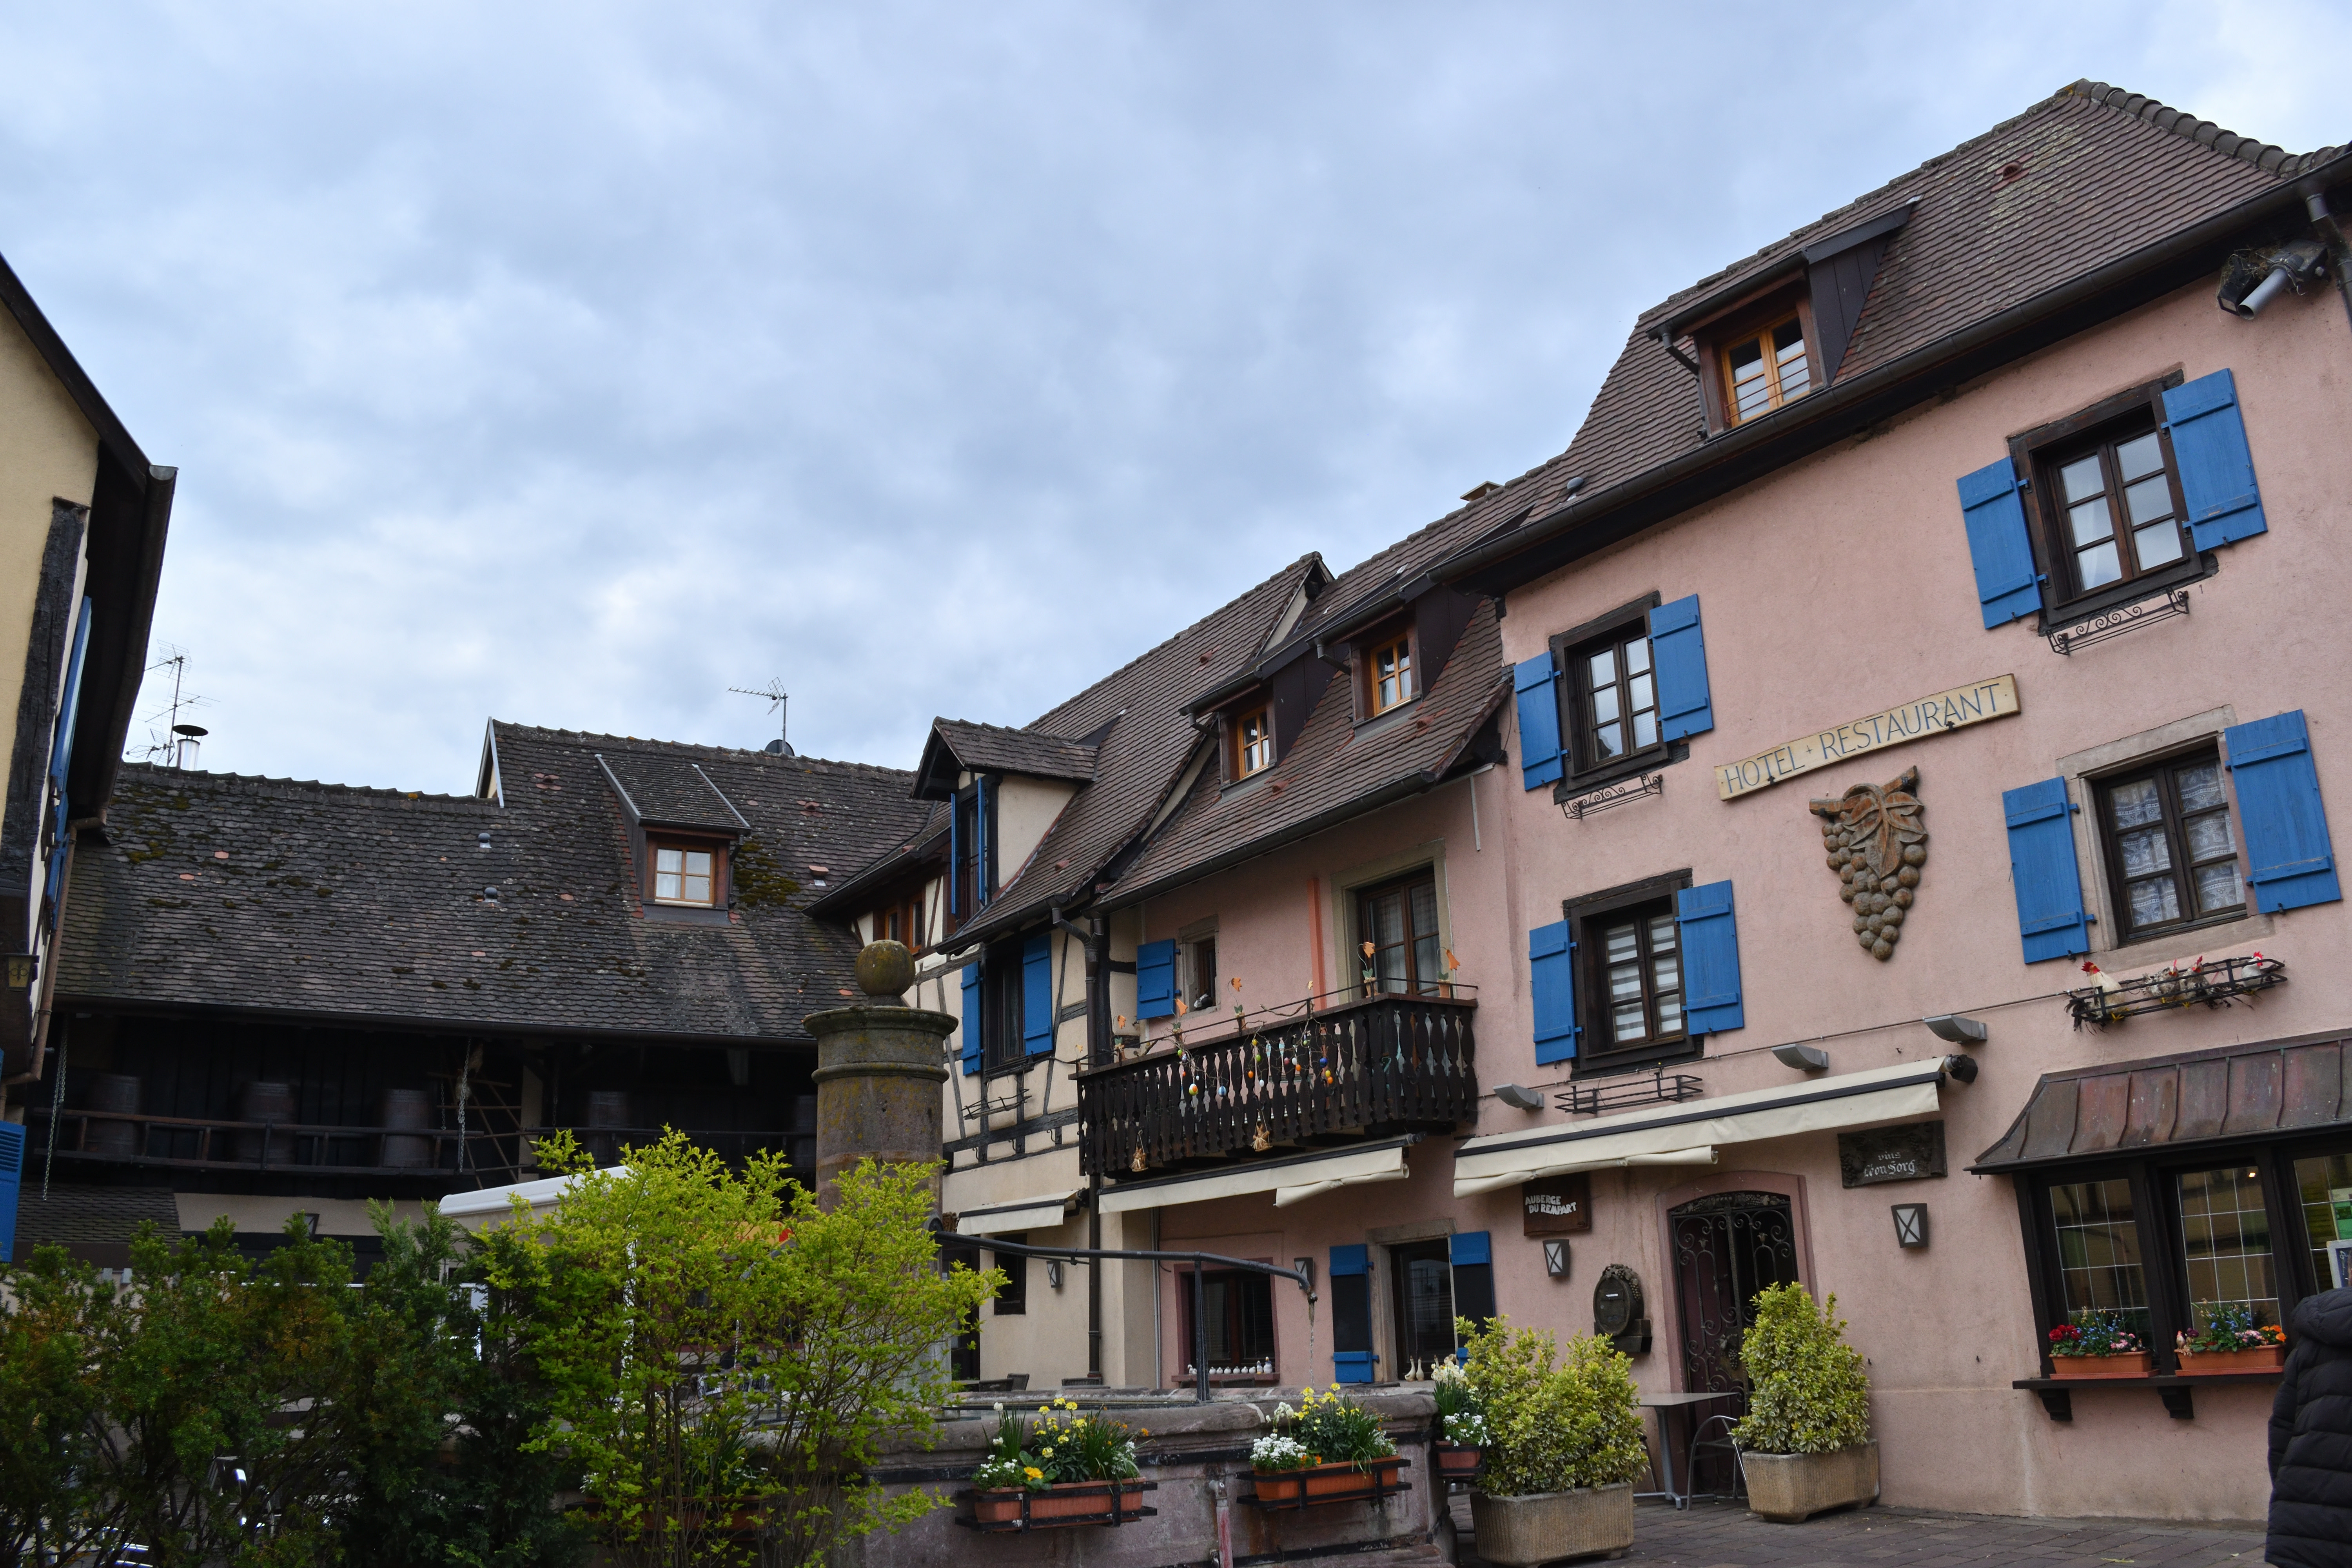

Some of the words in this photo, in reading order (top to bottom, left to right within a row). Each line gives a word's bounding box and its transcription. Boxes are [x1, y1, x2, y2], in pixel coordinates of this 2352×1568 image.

[1725, 746, 1805, 793] HOTEL
[1819, 683, 1999, 760] RESTAURANT
[1525, 1195, 1561, 1205] AUBERGE
[1529, 1204, 1539, 1214] DU
[1541, 1201, 1577, 1215] REMPART
